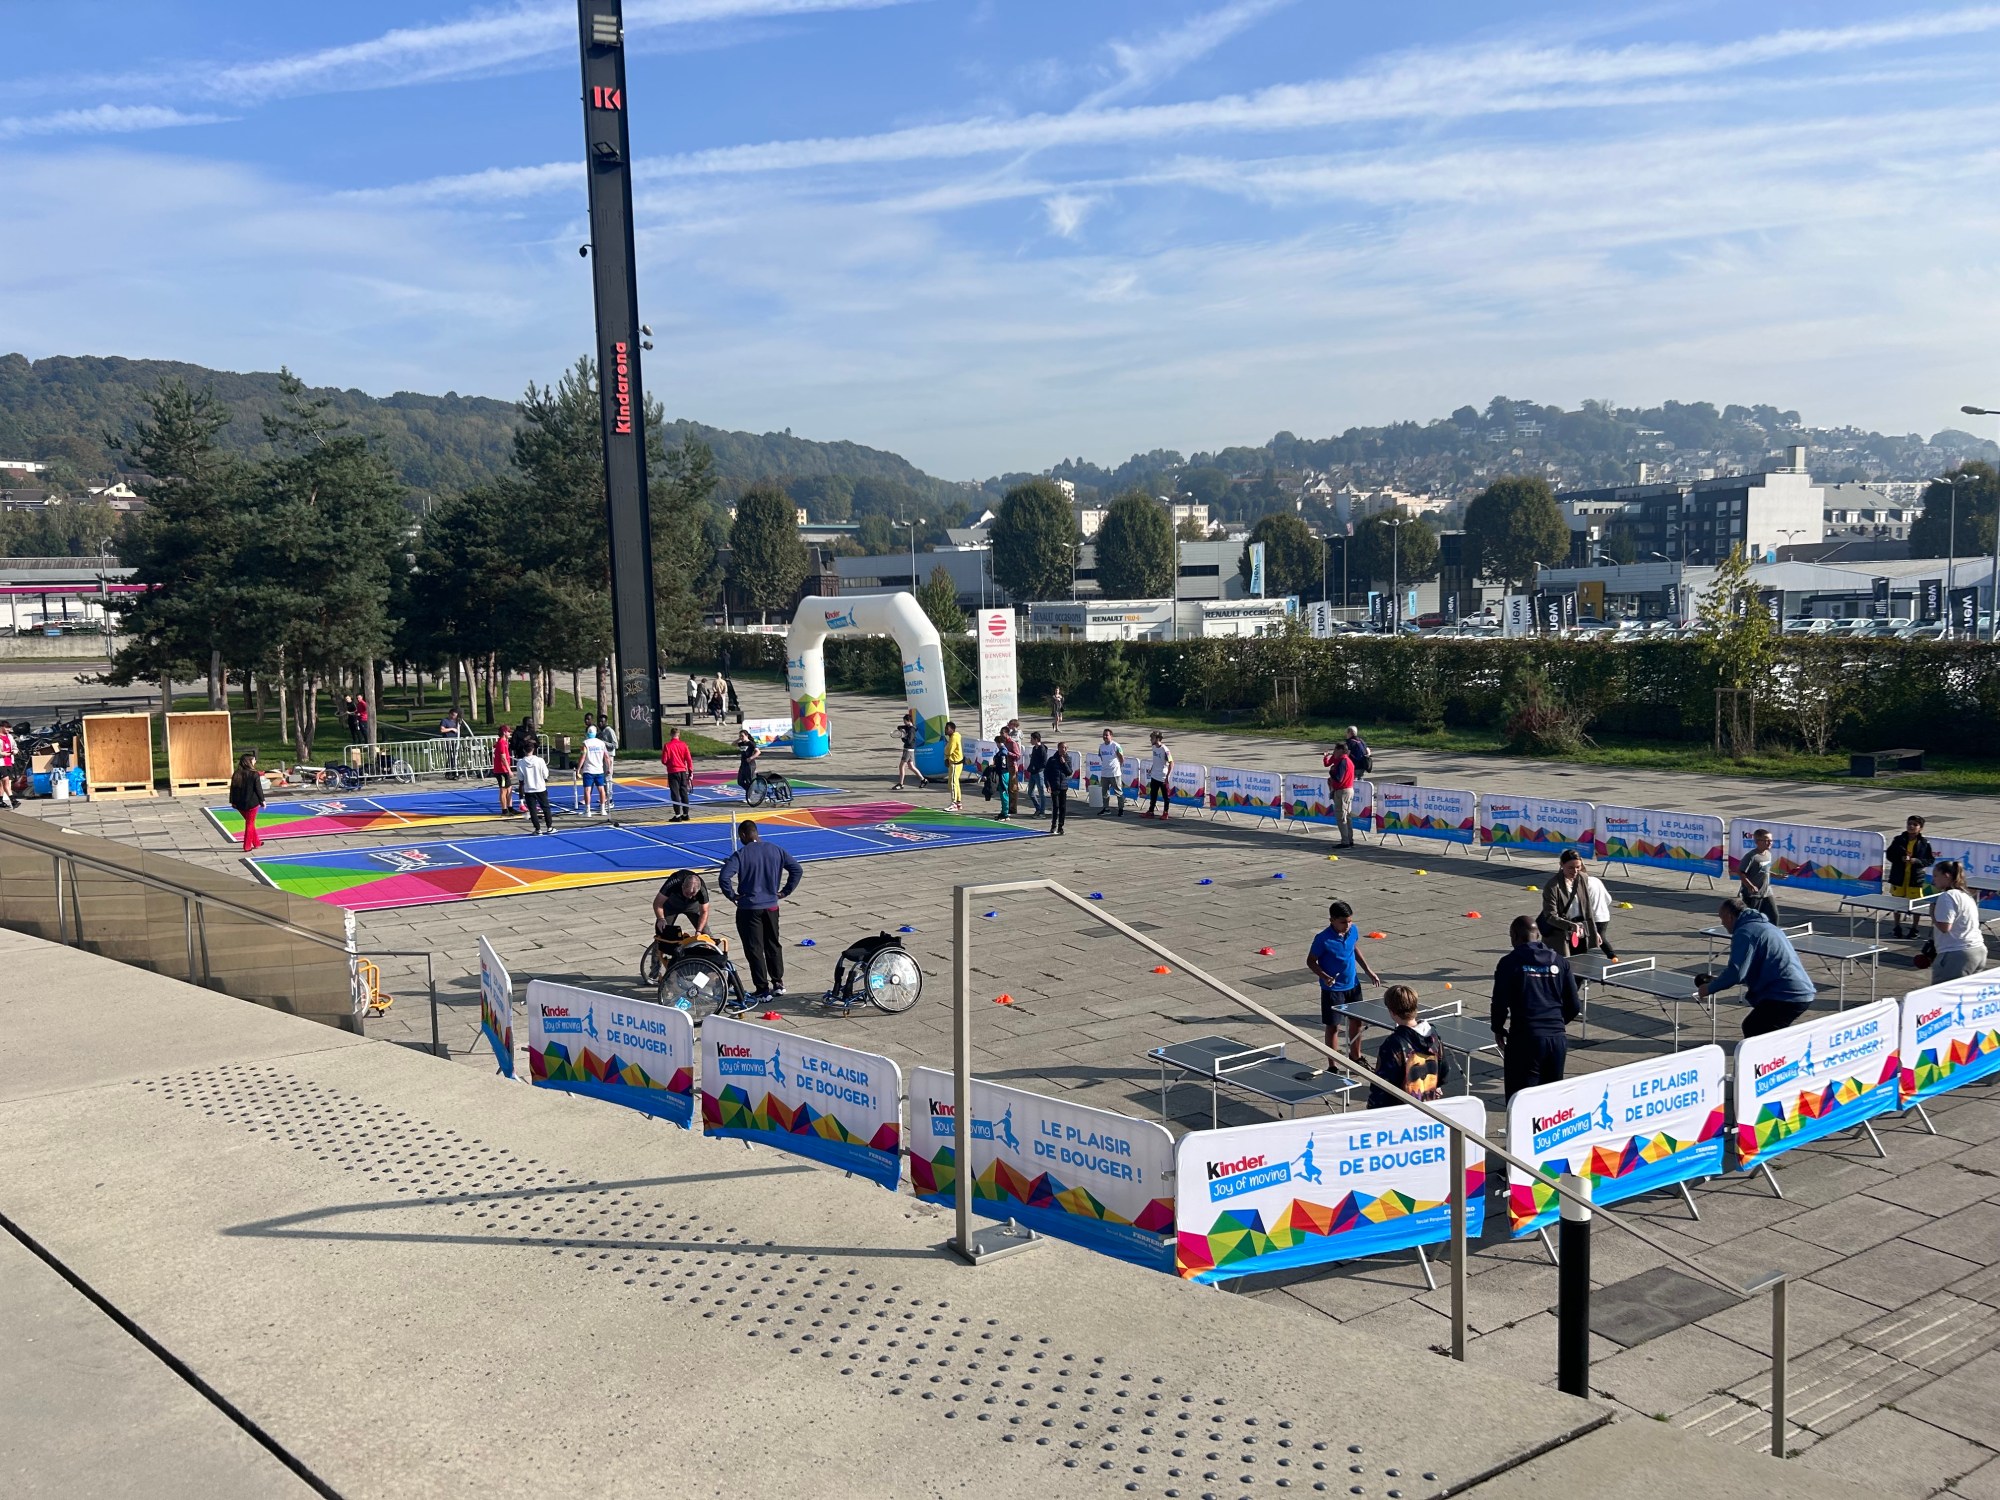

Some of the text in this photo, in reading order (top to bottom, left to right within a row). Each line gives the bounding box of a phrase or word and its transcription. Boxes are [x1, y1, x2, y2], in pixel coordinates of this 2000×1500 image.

[616, 342, 631, 433] Kindarena
[1034, 612, 1053, 622] RENAULT
[1205, 608, 1284, 618] RENAULT occasions
[1548, 816, 1578, 825] BOUGER
[1550, 807, 1578, 815] PLAISIR
[1661, 820, 1704, 831] LE PLAISIR
[1670, 831, 1705, 841] BOUGER
[1804, 845, 1818, 854] DE
[1820, 847, 1861, 860] BOUGER
[1809, 835, 1862, 848] LE PLAISIR
[541, 1003, 569, 1017] Kinder
[1916, 1007, 1942, 1028] Kinder
[1972, 1006, 1983, 1020] DE
[611, 1012, 666, 1036] LE PLAISIR
[1829, 1020, 1878, 1048] LE PLAISIR
[607, 1029, 621, 1043] DE
[623, 1033, 667, 1055] BOUGER
[717, 1042, 750, 1057] Kinder
[721, 1060, 764, 1074] Joy of moving
[802, 1056, 869, 1087] LE PLAISIR
[1754, 1055, 1786, 1079] Kinder
[796, 1074, 877, 1110] DE BOUGER !
[1632, 1069, 1698, 1099] LE PLAISIR
[1625, 1088, 1705, 1123] DE BOUGER !
[935, 1120, 949, 1134] Joy
[1532, 1107, 1574, 1135] Kinder
[1041, 1120, 1131, 1157] LE PLAISIR
[1349, 1123, 1446, 1151] LE PLAISIR
[1536, 1119, 1590, 1150] Joy of moving
[1034, 1140, 1142, 1184] DE BOUGER !
[1206, 1154, 1265, 1181] Kinder
[1339, 1146, 1446, 1176] DE BOUGER
[1213, 1169, 1288, 1198] Joy of moving
